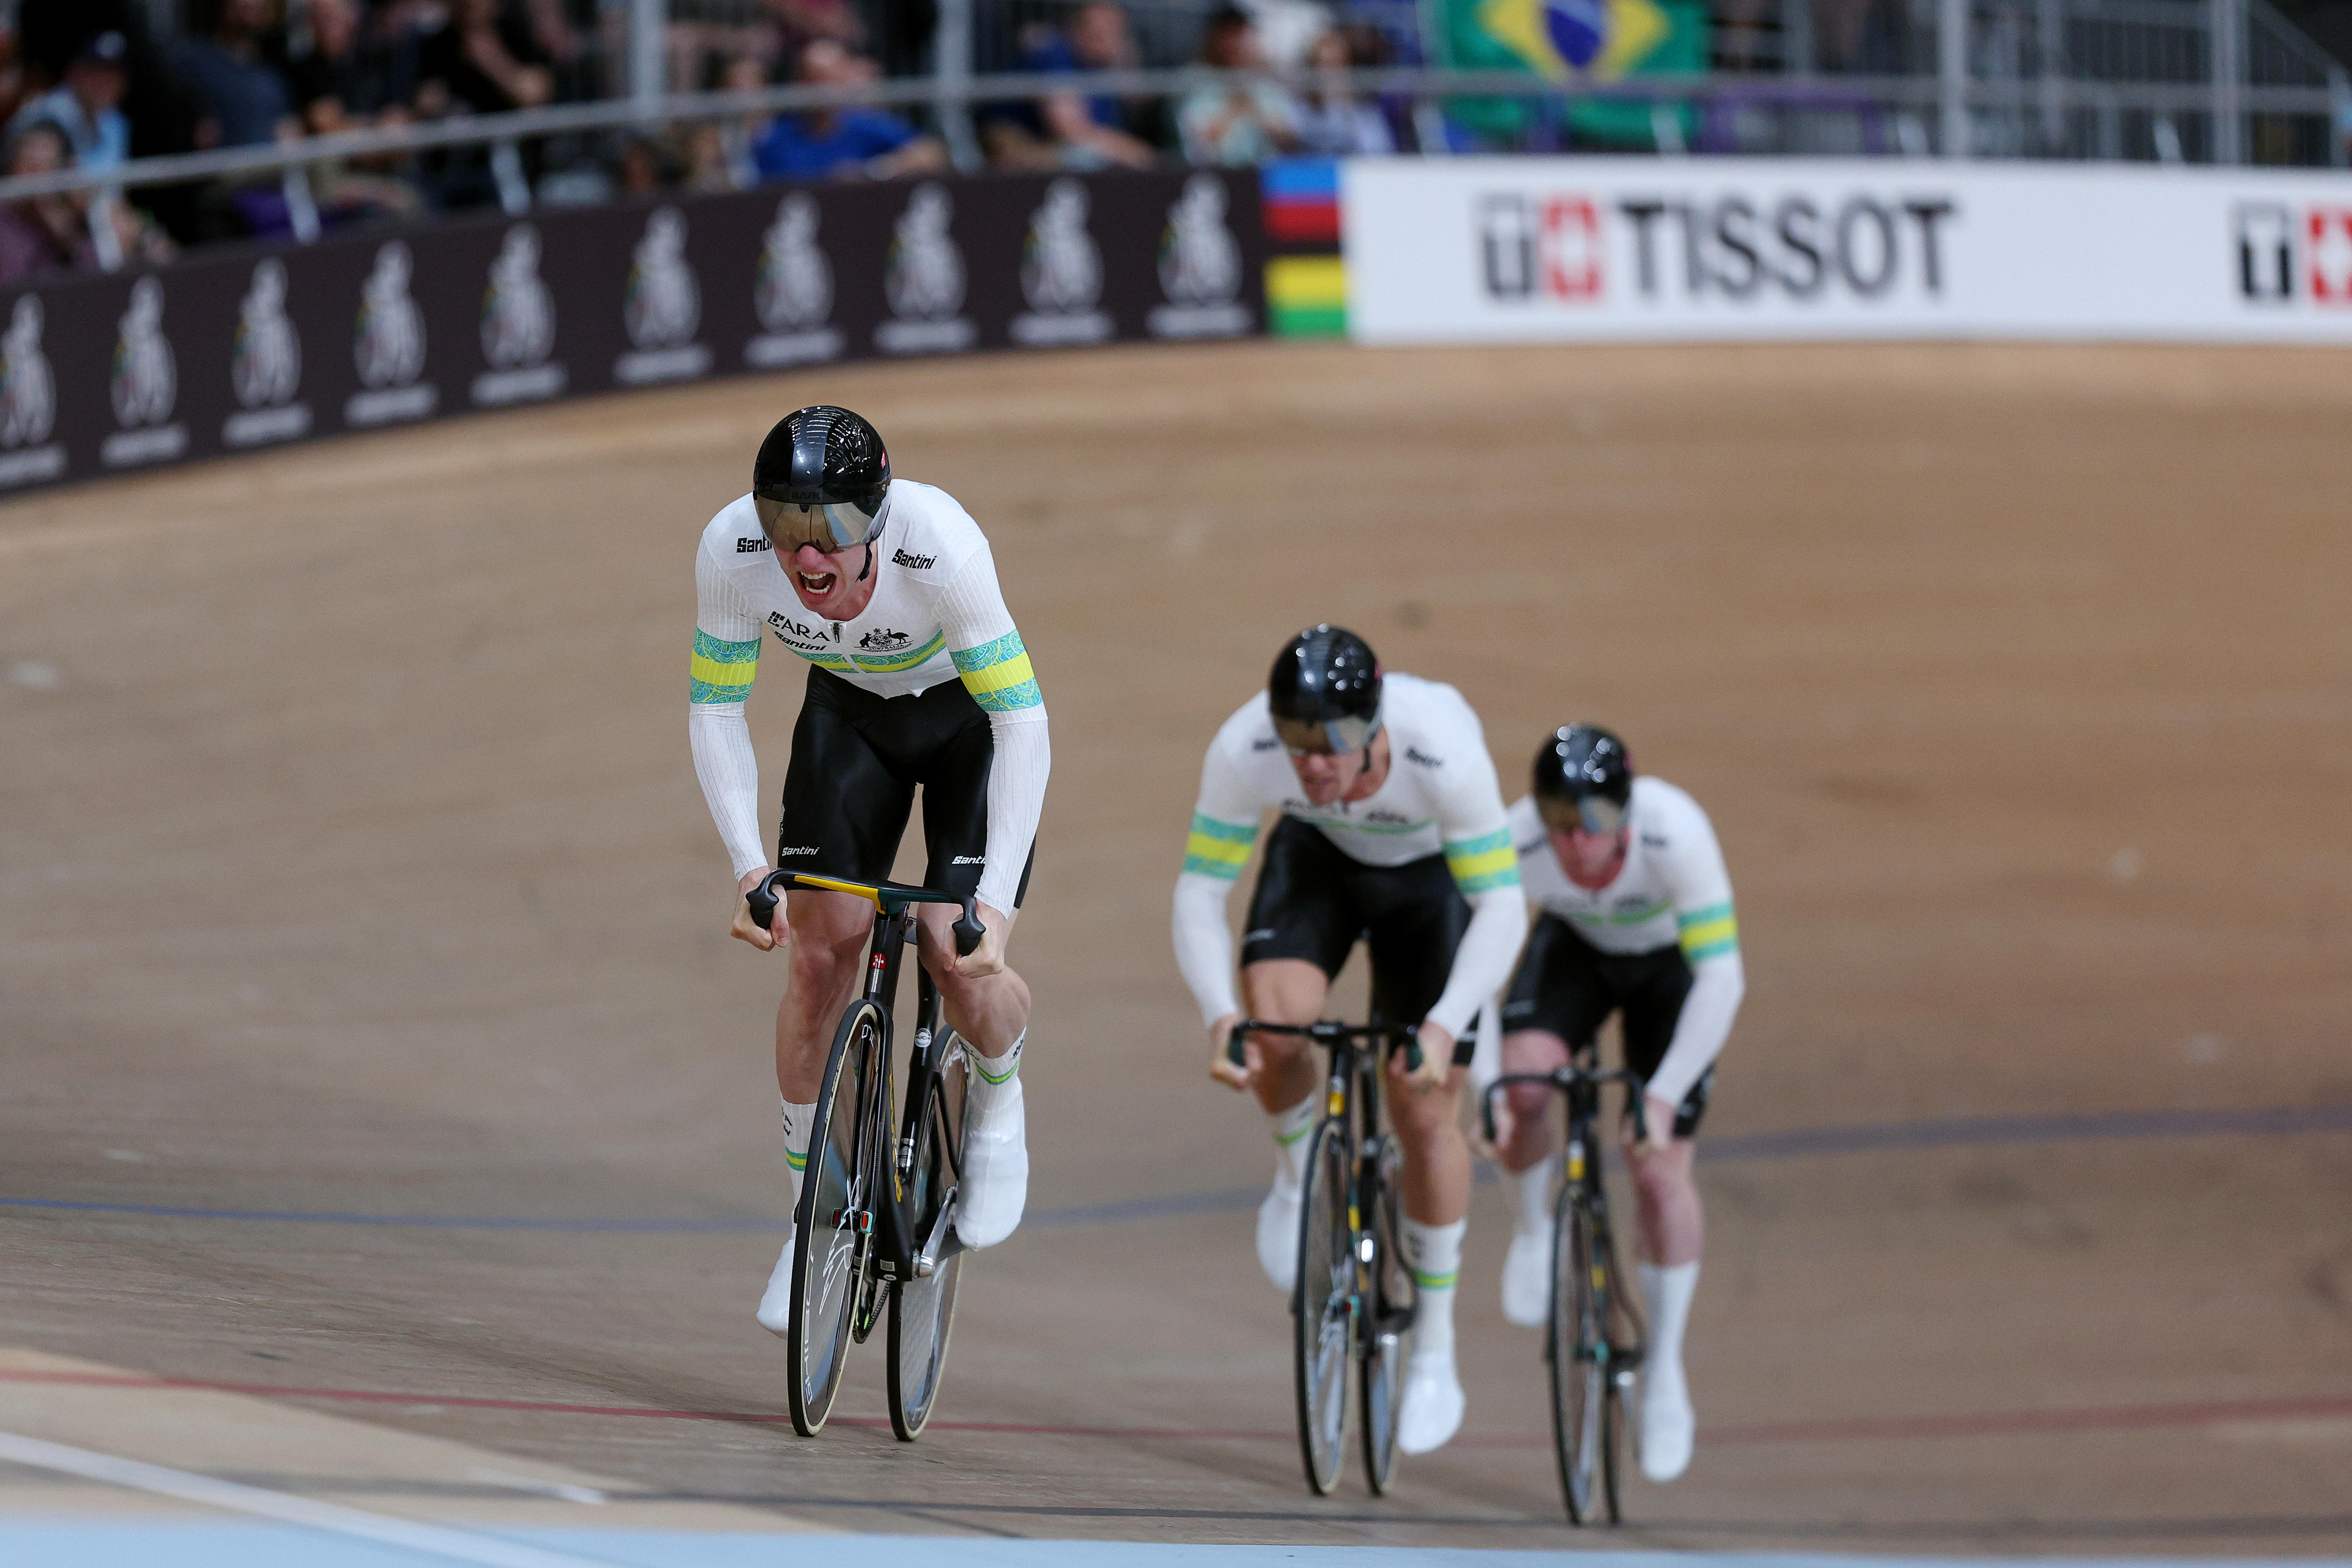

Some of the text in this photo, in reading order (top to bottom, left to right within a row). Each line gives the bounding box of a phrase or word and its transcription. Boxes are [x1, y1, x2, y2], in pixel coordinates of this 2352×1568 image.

[1619, 198, 1954, 298] TISSOT
[736, 536, 772, 553] Santi
[891, 549, 937, 569] Santini
[781, 618, 831, 642] ARA
[782, 846, 820, 856] Santini
[951, 855, 986, 864] Santi
